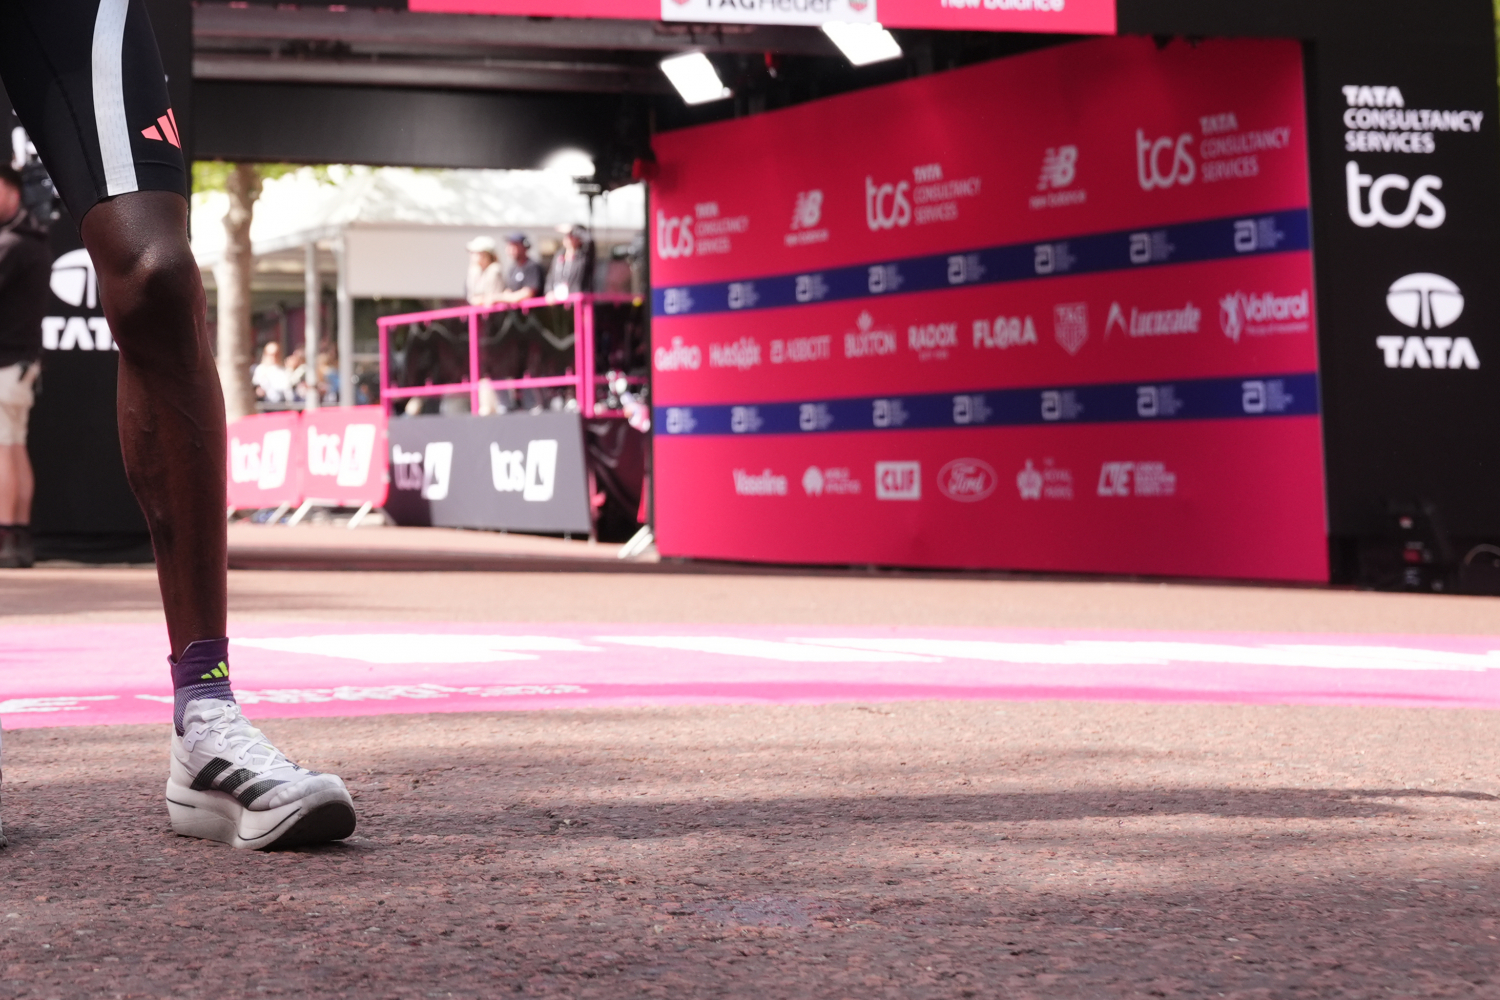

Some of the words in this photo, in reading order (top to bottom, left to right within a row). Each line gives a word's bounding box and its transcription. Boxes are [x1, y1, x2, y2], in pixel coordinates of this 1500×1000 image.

[1342, 85, 1405, 108] TATA
[1343, 108, 1484, 133] CONSULTANCY
[1136, 127, 1196, 191] tcs
[1345, 130, 1436, 154] SERVICES
[865, 175, 911, 231] tcs
[1346, 160, 1447, 229] tcs
[656, 208, 695, 260] tcs
[41, 316, 120, 350] TAT
[908, 322, 958, 351] RADOX
[972, 315, 1038, 349] FLORA
[1376, 335, 1481, 370] TATA
